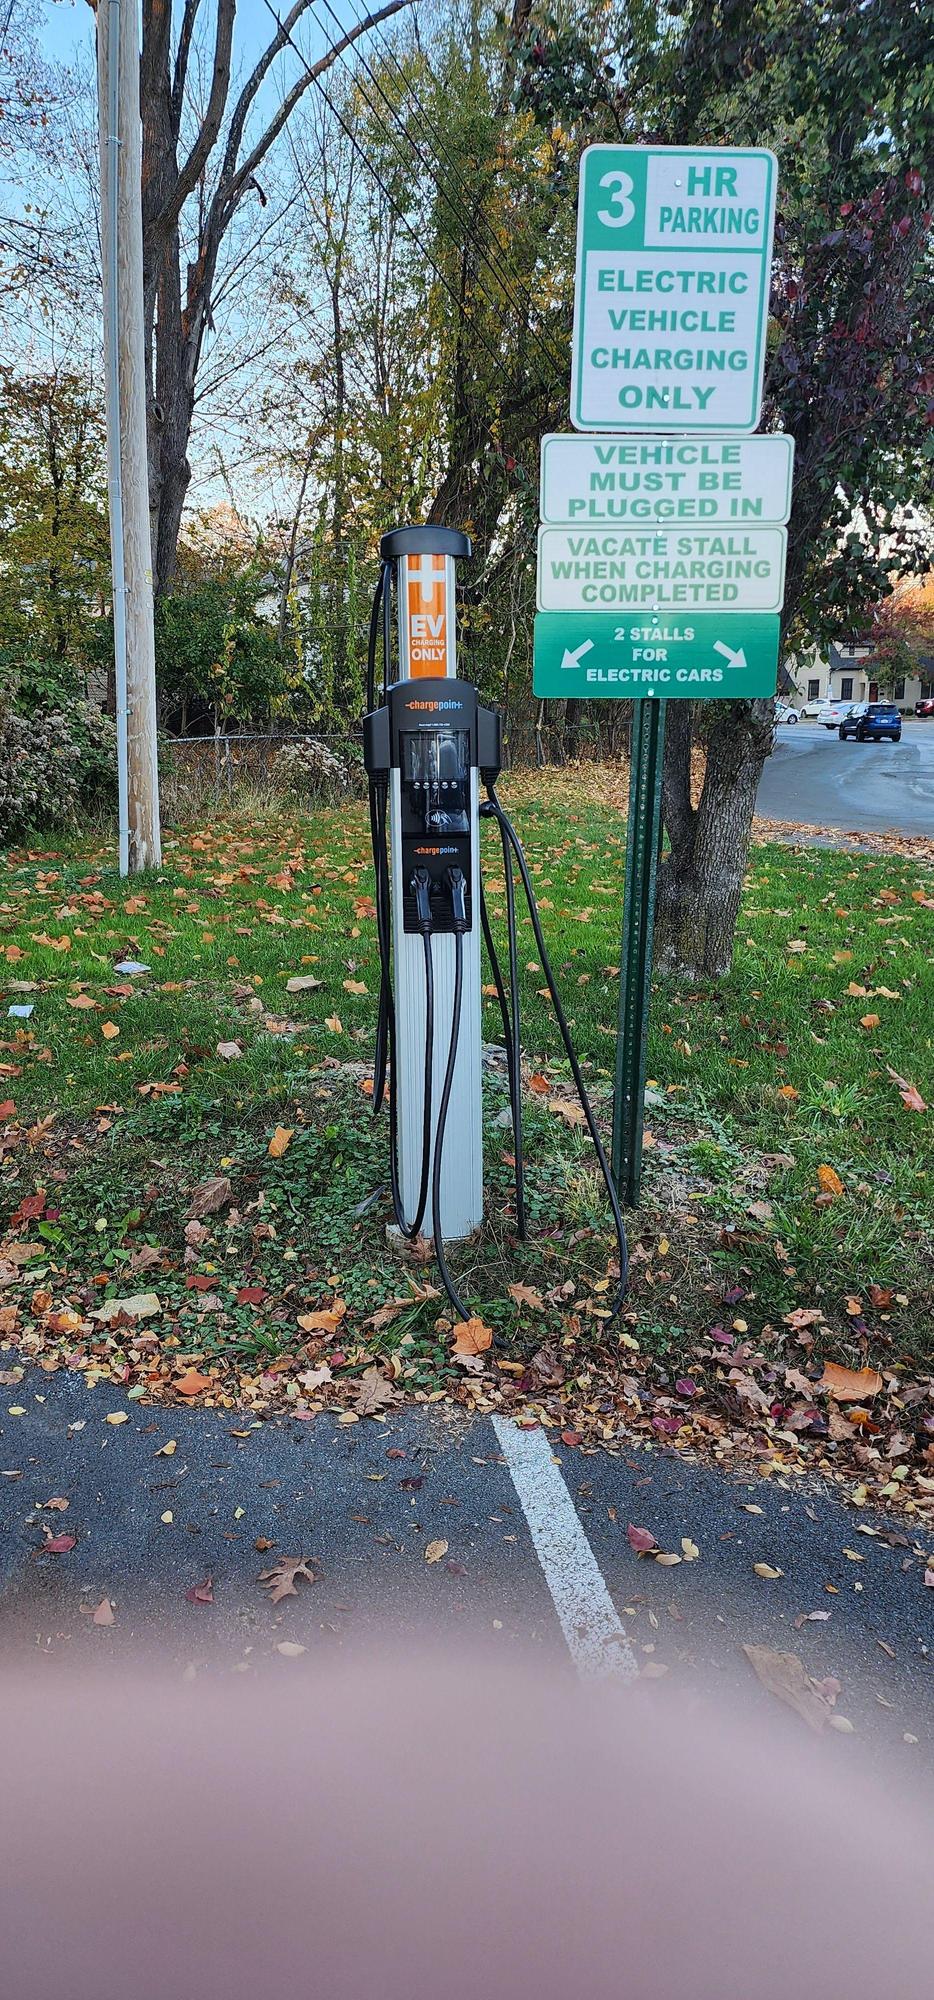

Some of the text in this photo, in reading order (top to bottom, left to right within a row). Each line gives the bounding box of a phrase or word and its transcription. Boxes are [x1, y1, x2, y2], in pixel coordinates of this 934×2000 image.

[597, 166, 737, 228] 3 HR
[659, 207, 759, 234] PARKING
[598, 270, 748, 294] ELECTRIC
[608, 309, 736, 332] VEHICLE
[590, 347, 748, 371] CHARGING
[618, 385, 716, 409] ONLY
[594, 445, 741, 465] VEHICLE
[590, 472, 742, 491] MUST BE
[568, 497, 762, 517] PLUGGED IN
[567, 537, 757, 556] VACATE STALL
[550, 560, 771, 579] WHEN CHARGING
[581, 583, 738, 602] COMPLETED
[411, 615, 444, 637] EV
[614, 628, 694, 641] 2 STALLS
[412, 649, 445, 660] ONLY
[632, 648, 667, 661] FOR
[587, 669, 723, 682] ELECTRIC CARS
